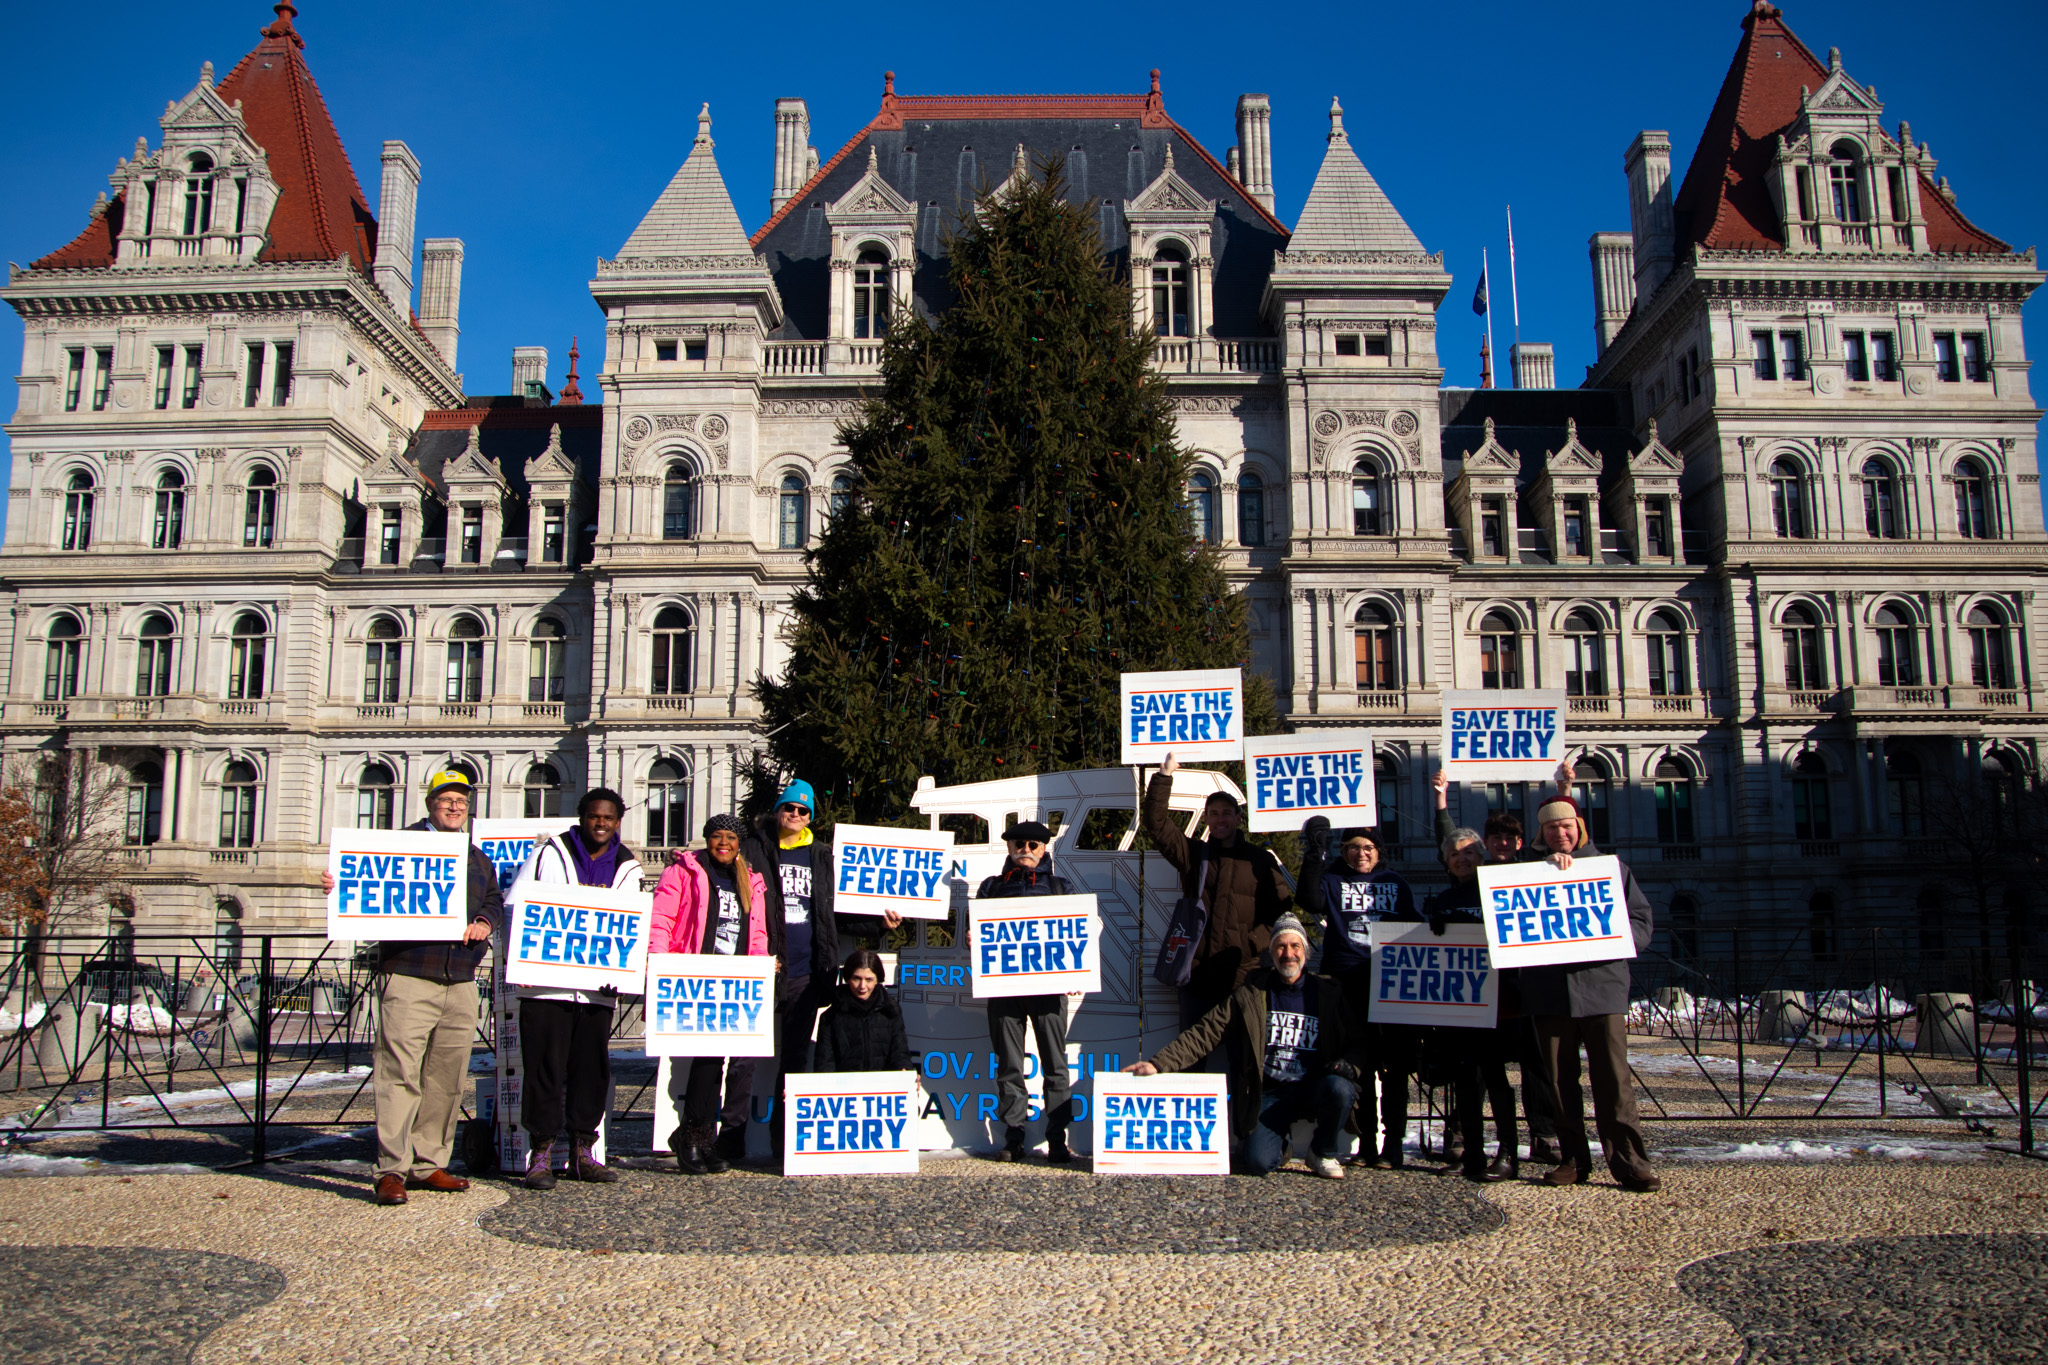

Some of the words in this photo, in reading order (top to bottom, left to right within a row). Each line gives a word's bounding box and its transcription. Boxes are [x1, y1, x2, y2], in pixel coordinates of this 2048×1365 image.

[1131, 693, 1186, 714] SAVE
[1191, 691, 1233, 712] THE
[1131, 712, 1232, 743] FERRY
[1452, 710, 1508, 730] SAVE
[1513, 709, 1556, 729] THE
[1451, 730, 1555, 759] FERRY
[1256, 756, 1314, 778] SAVE
[1319, 753, 1363, 775] THE
[1257, 775, 1363, 808] FERRY
[482, 840, 534, 861] SAVE
[842, 845, 898, 867] SAVE
[903, 850, 943, 870] THE
[340, 855, 404, 879] SAVE
[411, 857, 456, 880] THE
[795, 867, 812, 880] TH
[838, 865, 942, 898] FERRY
[1341, 883, 1373, 895] SAVE
[1375, 884, 1398, 896] THE
[339, 880, 455, 915] FERRY
[1341, 894, 1398, 911] FERRY
[1492, 886, 1559, 911] SAVE
[1562, 881, 1614, 905] THE
[523, 904, 589, 931] SAVE
[594, 911, 640, 937] THE
[980, 920, 1040, 943] SAVE
[1043, 918, 1089, 939] THE
[1495, 904, 1614, 944] FERRY
[519, 928, 638, 968] FERRY
[980, 940, 1089, 974] FERRY
[1381, 946, 1440, 968] SAVE
[1444, 947, 1489, 970] THE
[657, 978, 716, 1000] SAVE
[721, 980, 763, 1001] THE
[1380, 968, 1488, 1003] FERRY
[656, 1001, 763, 1032] FERRY
[1297, 1016, 1318, 1032] THE
[797, 1097, 857, 1119] SAVE
[862, 1096, 907, 1117] THE
[1105, 1097, 1166, 1119] SAVE
[1171, 1098, 1217, 1119] THE
[796, 1119, 907, 1151] FERRY
[1105, 1120, 1216, 1151] FERRY
